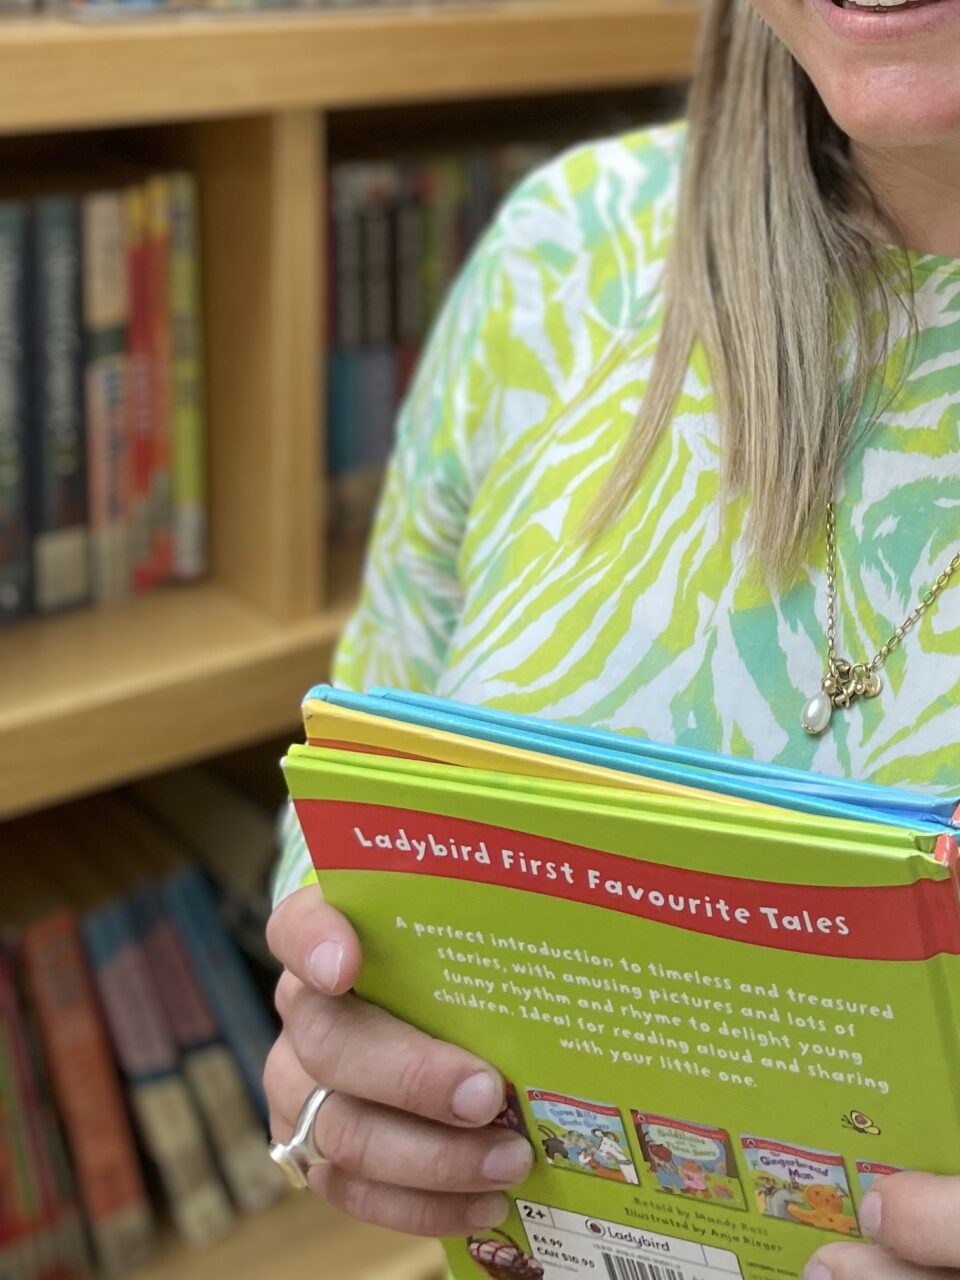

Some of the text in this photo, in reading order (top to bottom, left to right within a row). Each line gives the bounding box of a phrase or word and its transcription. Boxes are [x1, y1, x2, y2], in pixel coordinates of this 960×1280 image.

[353, 827, 849, 935] Ladybird First Favourite Tales
[396, 916, 894, 1019] A perfect introduction to timeless and treasured
[438, 947, 855, 1037] stories, with amusing pictures and lots of
[433, 989, 889, 1094] children. Ideal for reading aloud and sharing
[443, 969, 863, 1066] funny rhythm and rhyme to delight young
[560, 1038, 758, 1088] with your little one.
[760, 1156, 829, 1177] Gingerbread
[788, 1167, 814, 1180] Man
[523, 1205, 546, 1220] 2+
[624, 1207, 689, 1230] Illustrated
[692, 1223, 706, 1236] by
[607, 1227, 670, 1251] Ladybird
